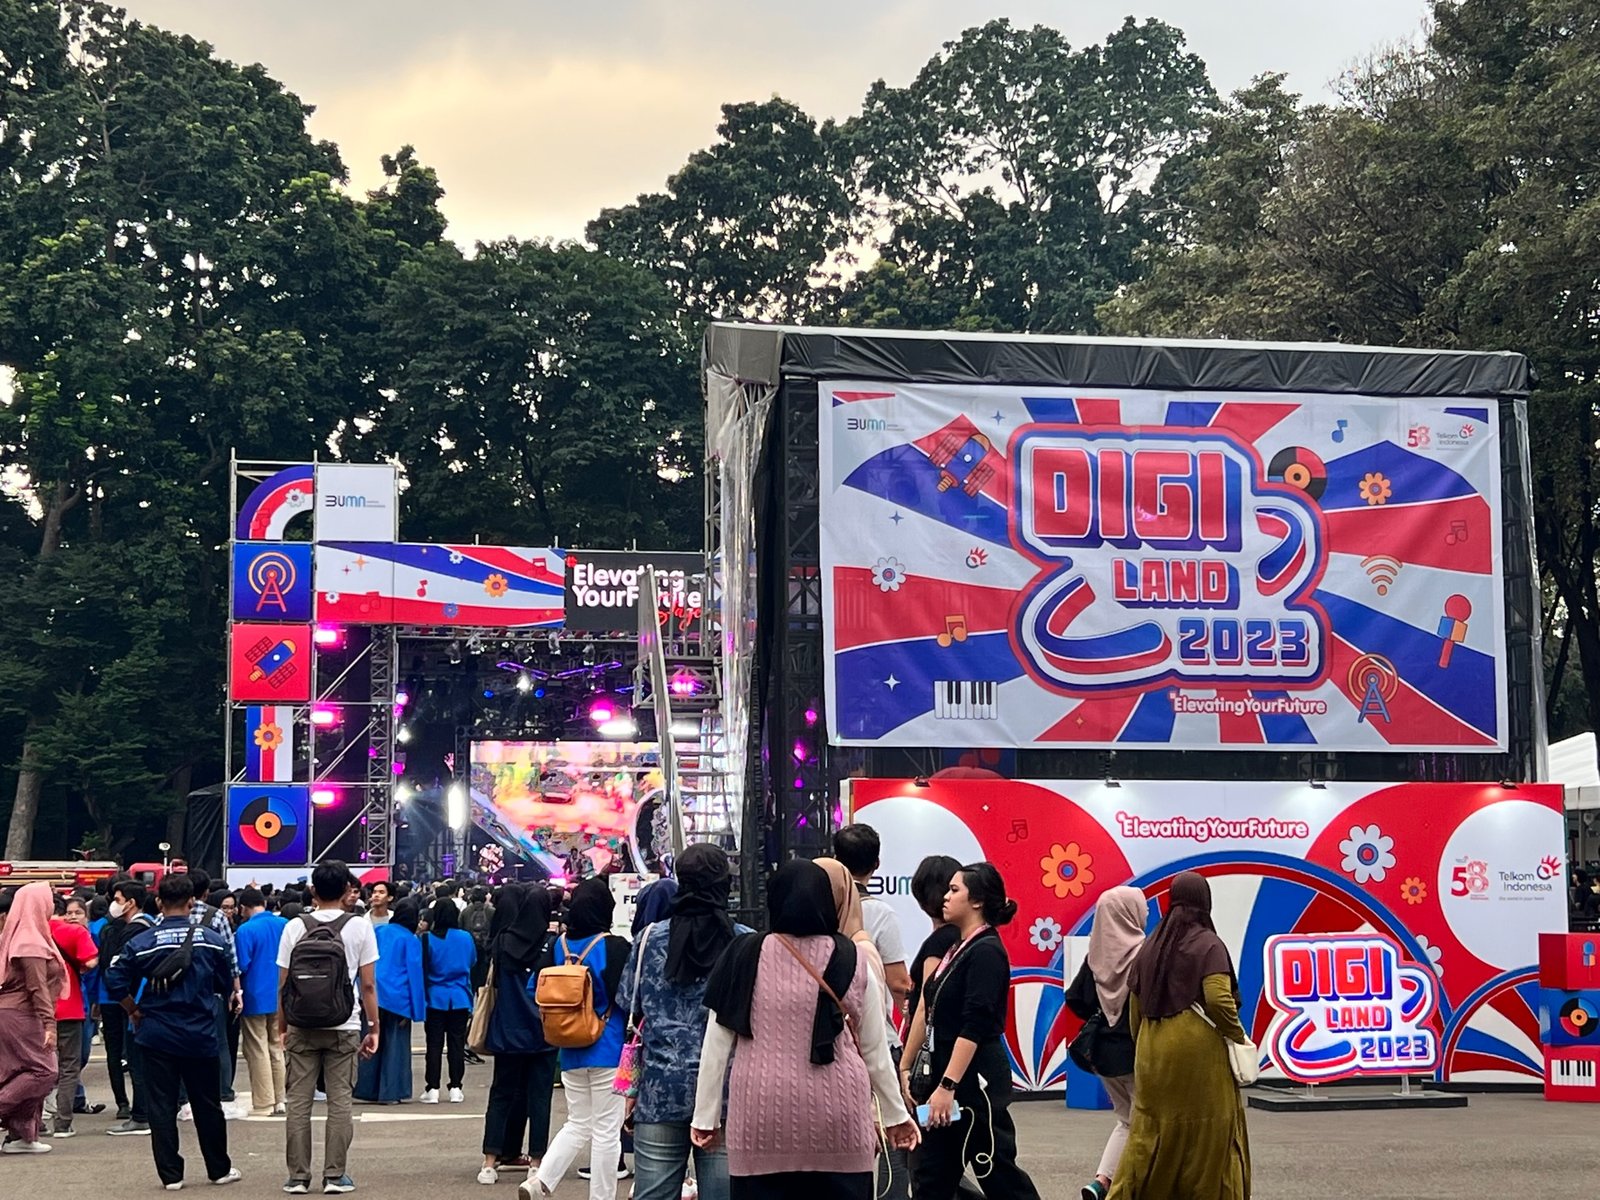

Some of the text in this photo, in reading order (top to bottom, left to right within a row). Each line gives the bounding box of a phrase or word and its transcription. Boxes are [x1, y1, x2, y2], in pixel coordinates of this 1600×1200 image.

[325, 495, 366, 508] BUMN
[1031, 446, 1242, 552] DIGI
[573, 562, 685, 592] Elevang
[1111, 557, 1240, 610] LAND
[1177, 616, 1311, 667] 2023
[866, 875, 912, 895] BUM
[1498, 871, 1535, 881] Telkom
[1503, 881, 1553, 892] Indonesia
[1281, 946, 1392, 1001] DIGI
[1325, 1005, 1392, 1033] LAND
[1359, 1034, 1430, 1062] 2023
